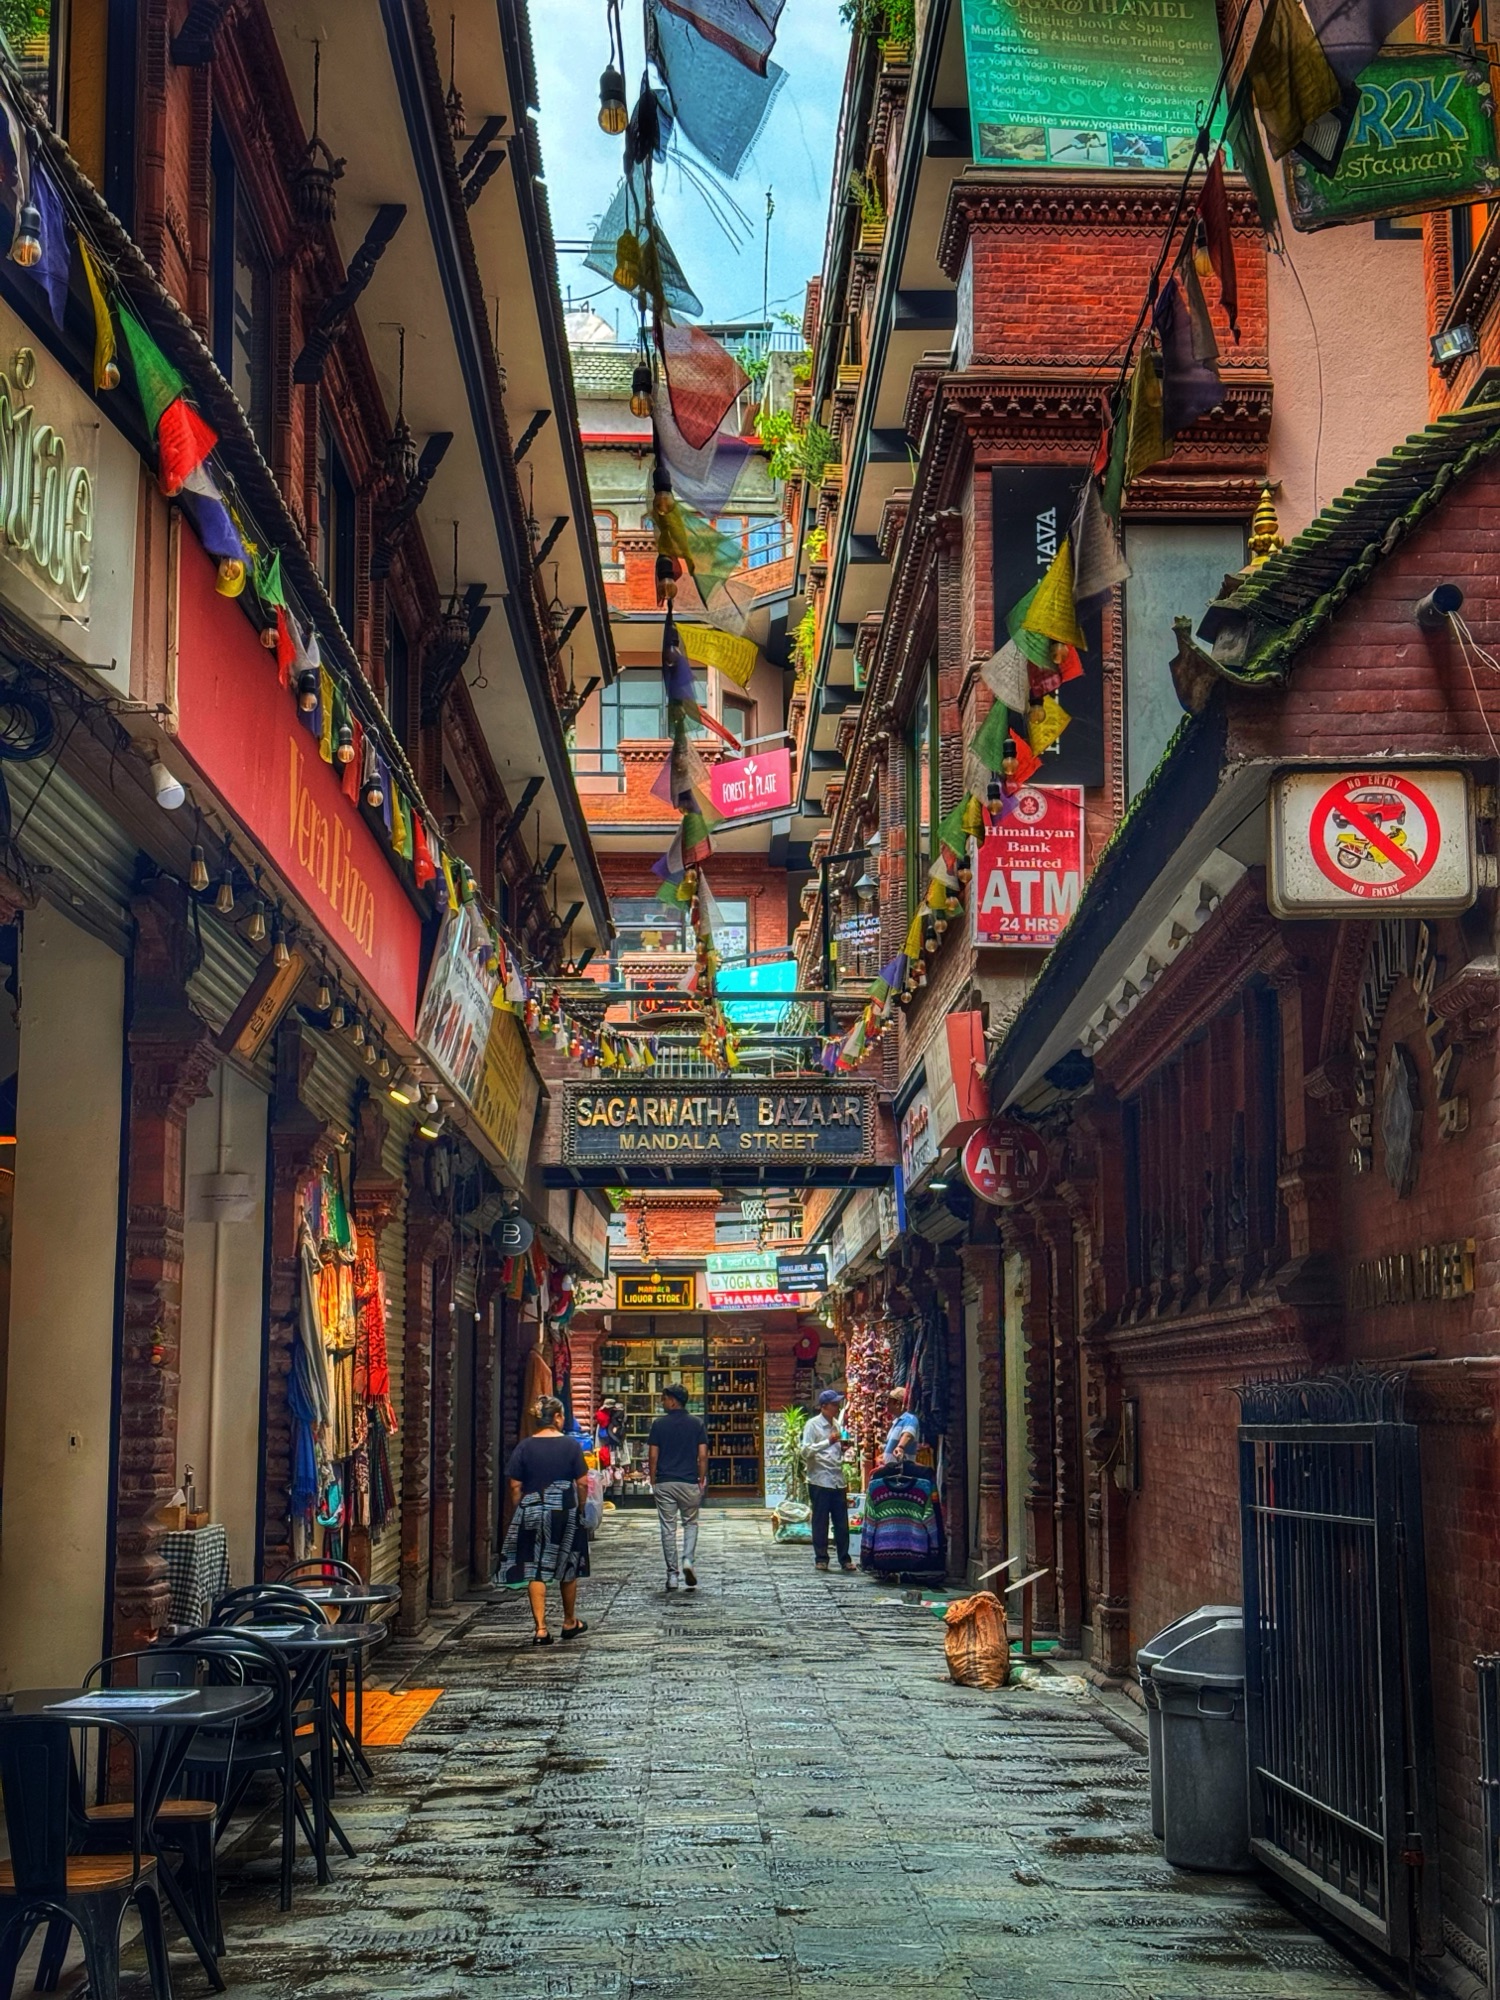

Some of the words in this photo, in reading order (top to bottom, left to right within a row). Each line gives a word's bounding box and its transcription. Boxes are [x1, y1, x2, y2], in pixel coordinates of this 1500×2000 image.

[1079, 17, 1113, 30] bowl
[1119, 20, 1131, 31] &
[1136, 21, 1164, 34] Spa
[971, 25, 1017, 38] Mandala
[1020, 28, 1047, 42] Yoga
[1051, 31, 1059, 40] &
[1062, 31, 1098, 43] Nature
[1102, 35, 1128, 46] Cure
[1130, 36, 1175, 51] Training
[1178, 39, 1214, 51] Center
[994, 44, 1039, 55] Services
[989, 57, 1012, 68] Yoga
[1025, 59, 1048, 70] Yoga
[1052, 61, 1089, 73] Therapy
[1140, 54, 1185, 66] Training
[989, 71, 1020, 81] Sound
[1023, 72, 1057, 85] healing
[1070, 77, 1108, 88] Therapy
[1137, 81, 1176, 92] Advance
[1179, 84, 1209, 93] course
[991, 85, 1041, 96] Meditation
[1138, 95, 1161, 105] Yoga
[1345, 70, 1469, 152] R2K
[1008, 113, 1058, 125] Website:
[1060, 118, 1193, 135] www.yogaatthamel.com
[722, 780, 746, 803] FOREST
[755, 773, 777, 796] PLATE
[1346, 777, 1362, 790] NO
[1368, 775, 1401, 789] ENTRY
[289, 735, 330, 895] Vera
[984, 825, 1075, 840] Himalayan
[1007, 841, 1052, 853] Bank
[996, 857, 1062, 869] Limited
[329, 812, 375, 959] Pizza
[980, 870, 1081, 916] ATM
[1351, 882, 1365, 895] NO
[1371, 883, 1400, 897] ENTRY
[1000, 917, 1020, 931] 24
[1025, 917, 1059, 932] HRS
[577, 1097, 741, 1127] SAGARMATHA
[758, 1097, 861, 1126] BAZAAR
[619, 1133, 721, 1150] MANDALA
[740, 1132, 819, 1150] STREET
[722, 1275, 752, 1289] YOGA
[755, 1274, 763, 1288] &
[624, 1294, 653, 1304] LIQUOR
[656, 1294, 680, 1303] STORE
[715, 1293, 793, 1305] PHARMACY
